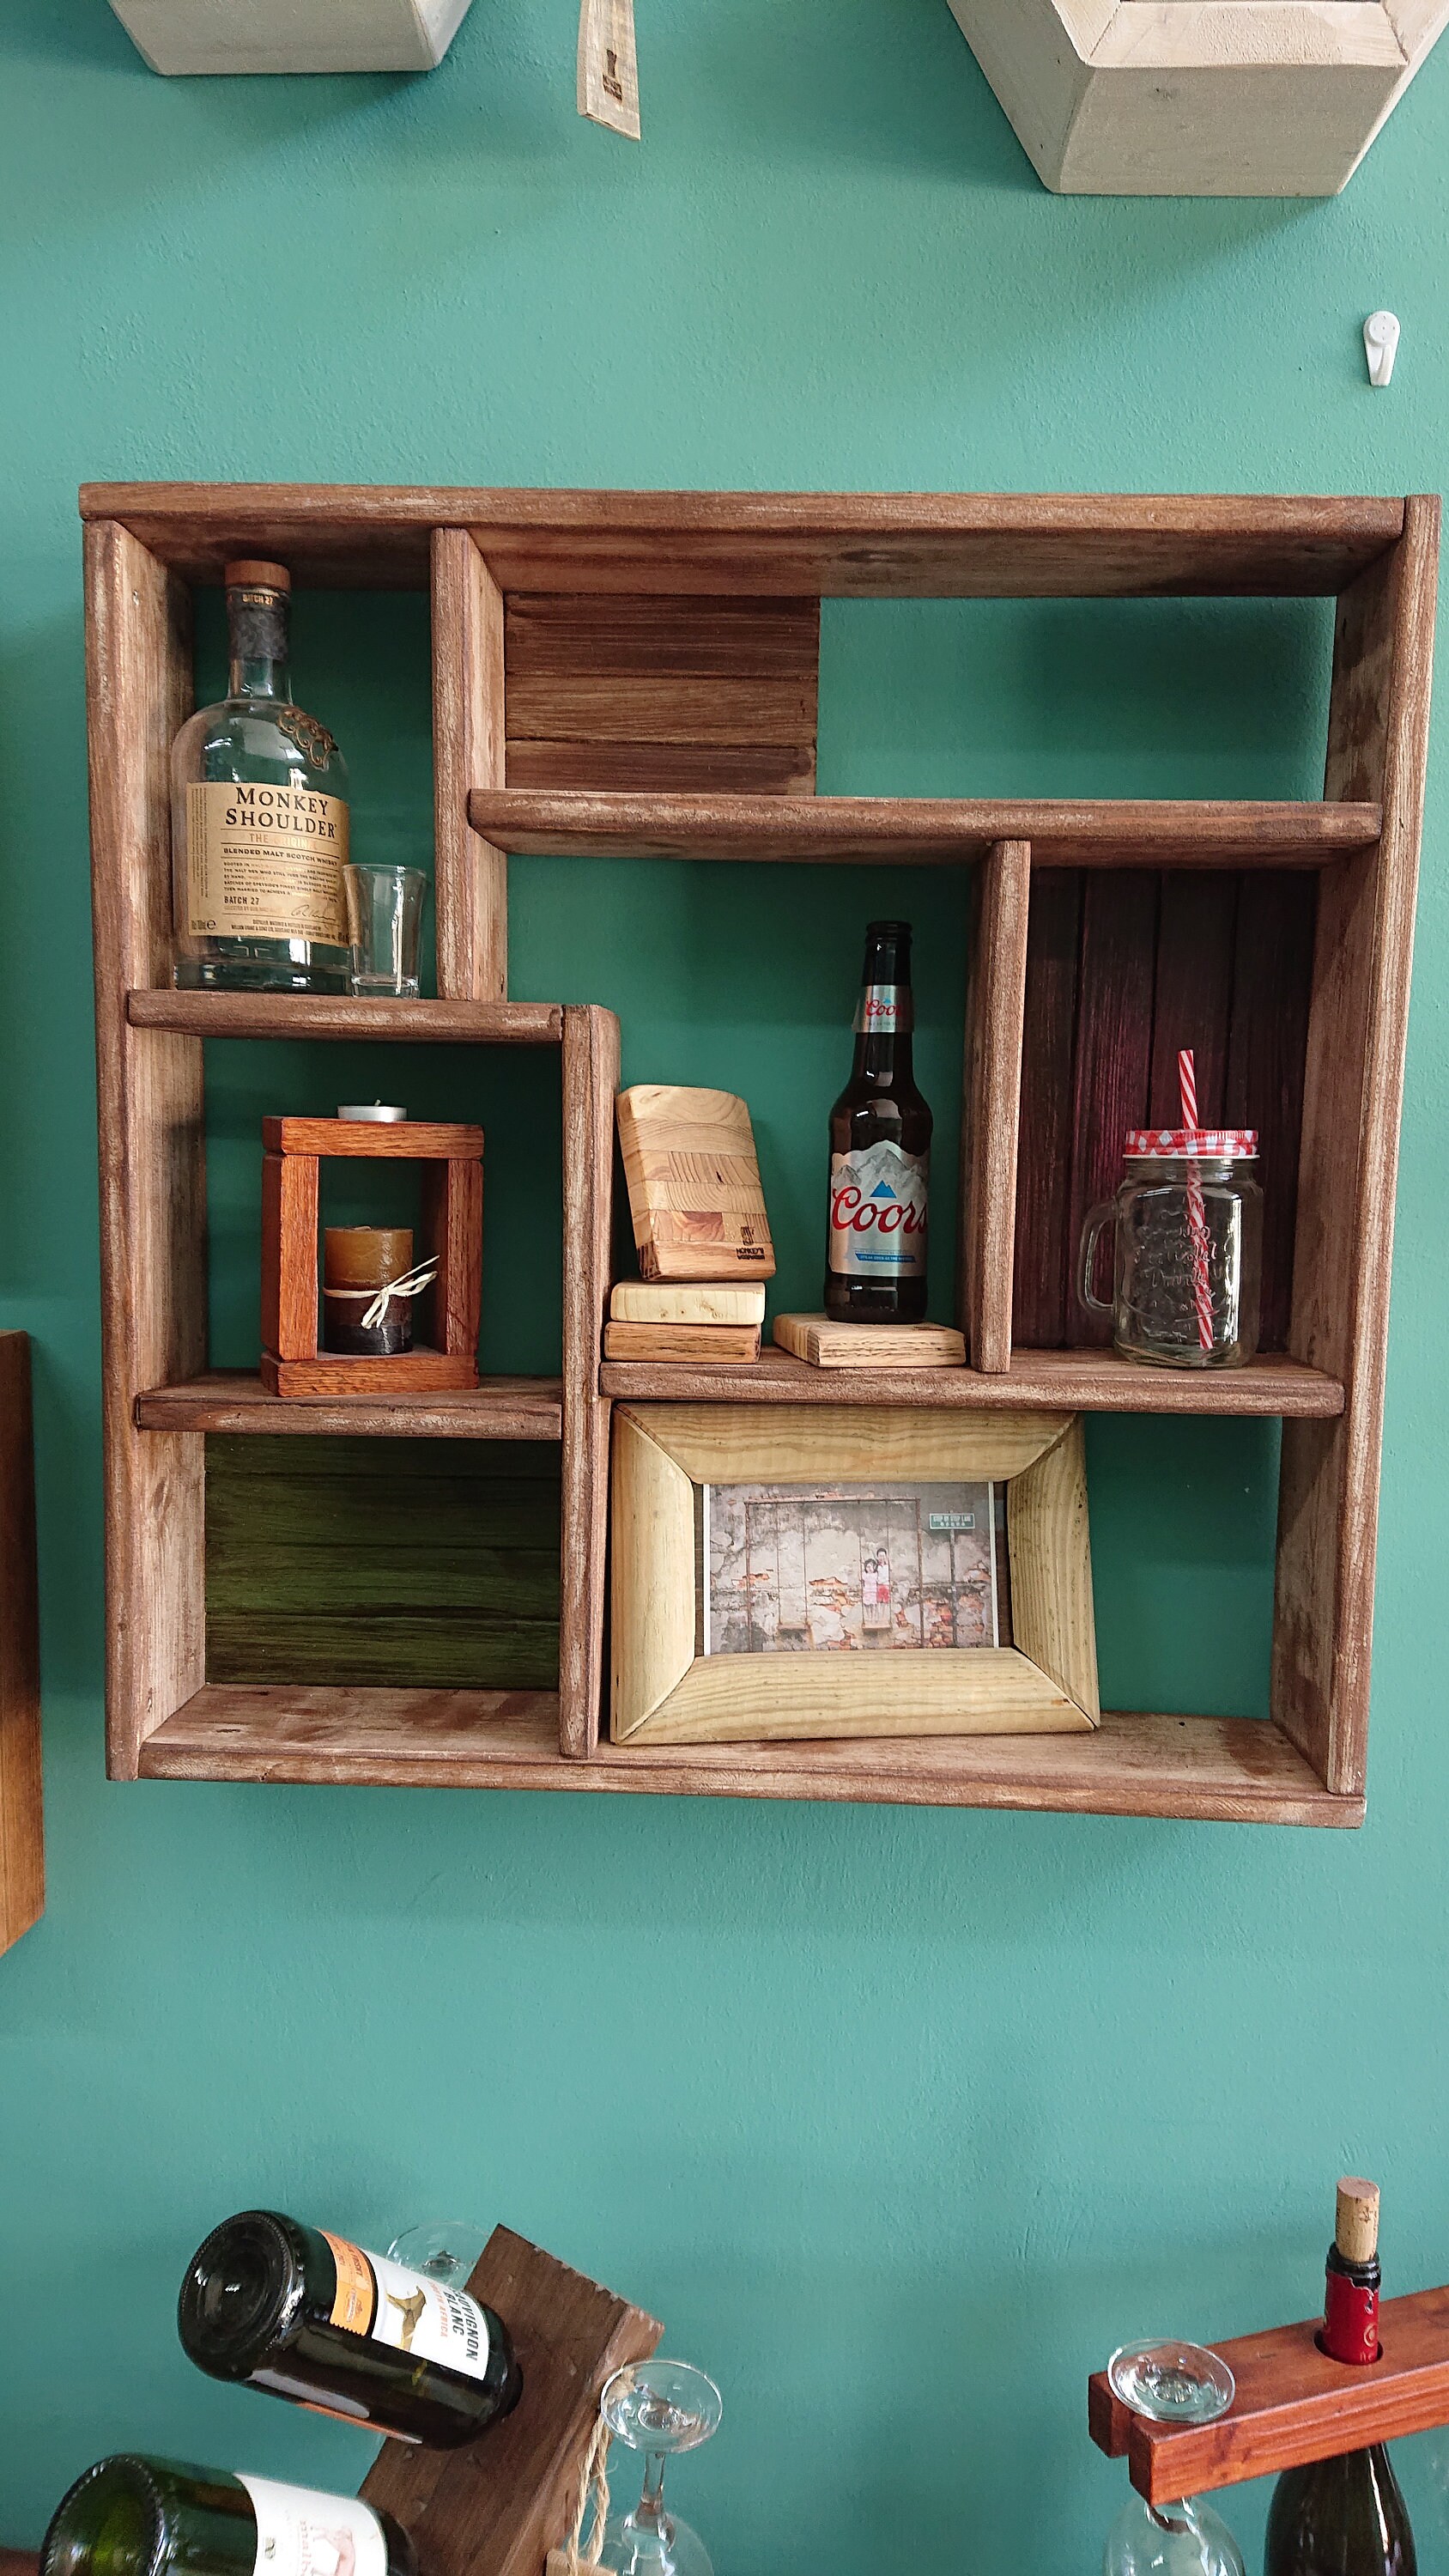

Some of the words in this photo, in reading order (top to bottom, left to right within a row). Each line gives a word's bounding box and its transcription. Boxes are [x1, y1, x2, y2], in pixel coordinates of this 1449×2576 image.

[236, 787, 328, 816] MONKEY
[225, 808, 336, 839] SHOULDER
[249, 833, 269, 844] THE
[263, 850, 285, 858] MALT
[286, 852, 315, 863] SCOTCH
[316, 857, 337, 866] WHISKY
[224, 896, 247, 905] BATCH
[250, 897, 260, 905] 27
[866, 999, 906, 1017] Coor
[832, 1186, 928, 1234] Coors
[443, 2291, 464, 2336] BLANC
